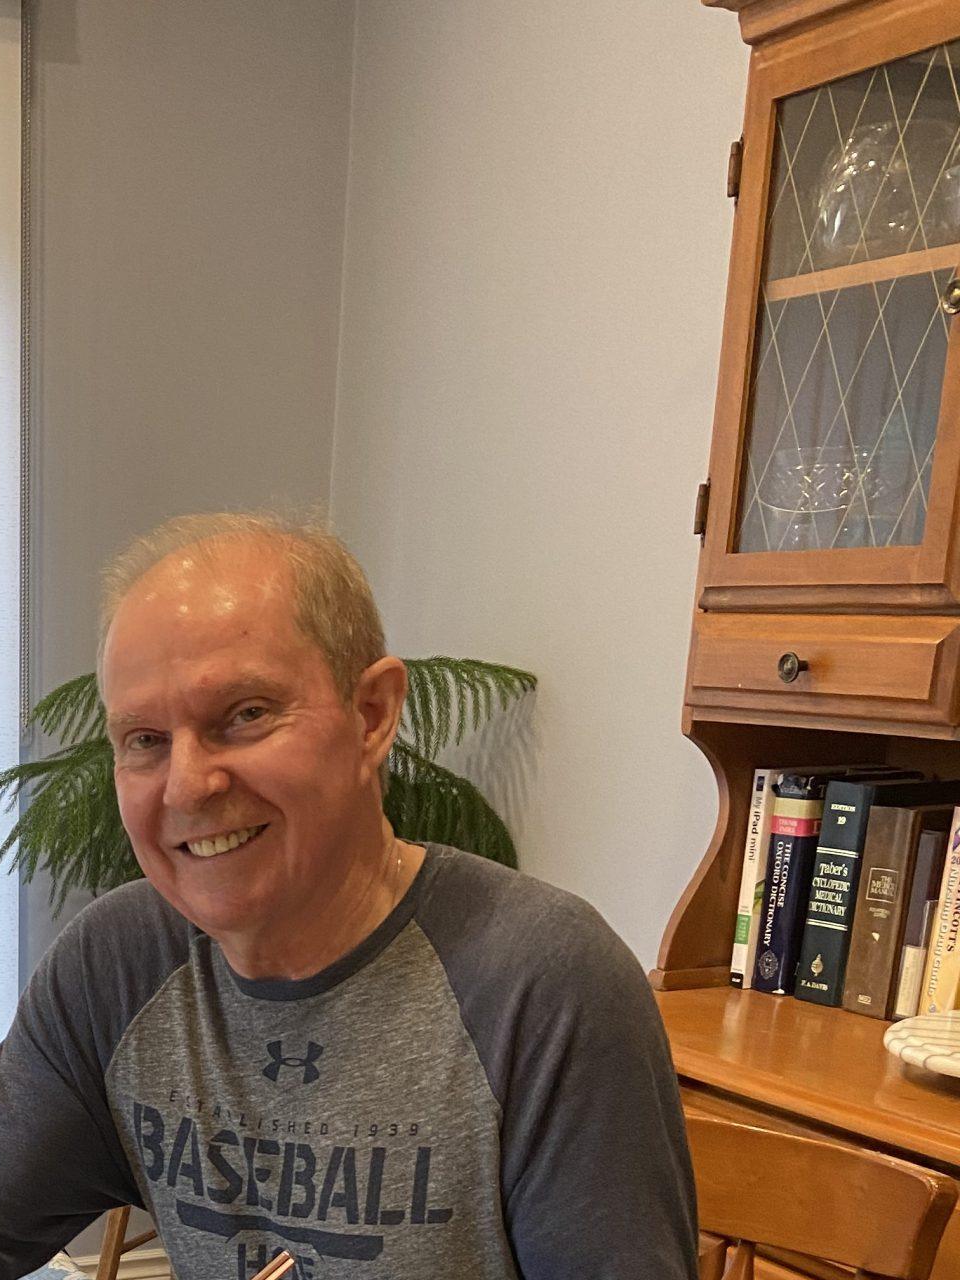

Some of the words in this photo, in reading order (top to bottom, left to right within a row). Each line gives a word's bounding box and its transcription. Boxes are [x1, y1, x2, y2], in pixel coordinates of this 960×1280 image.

[751, 811, 761, 836] iPad
[772, 841, 784, 884] OXFORD
[785, 843, 793, 864] THE
[820, 863, 848, 877] Taber's
[777, 865, 791, 908] CONCISE
[812, 877, 850, 892] CYCLOPEDIC
[815, 890, 843, 904] MEDICAL
[763, 885, 778, 947] DICTIONARY
[353, 1123, 420, 1138] 1939
[133, 1102, 453, 1226] BASEBALL
